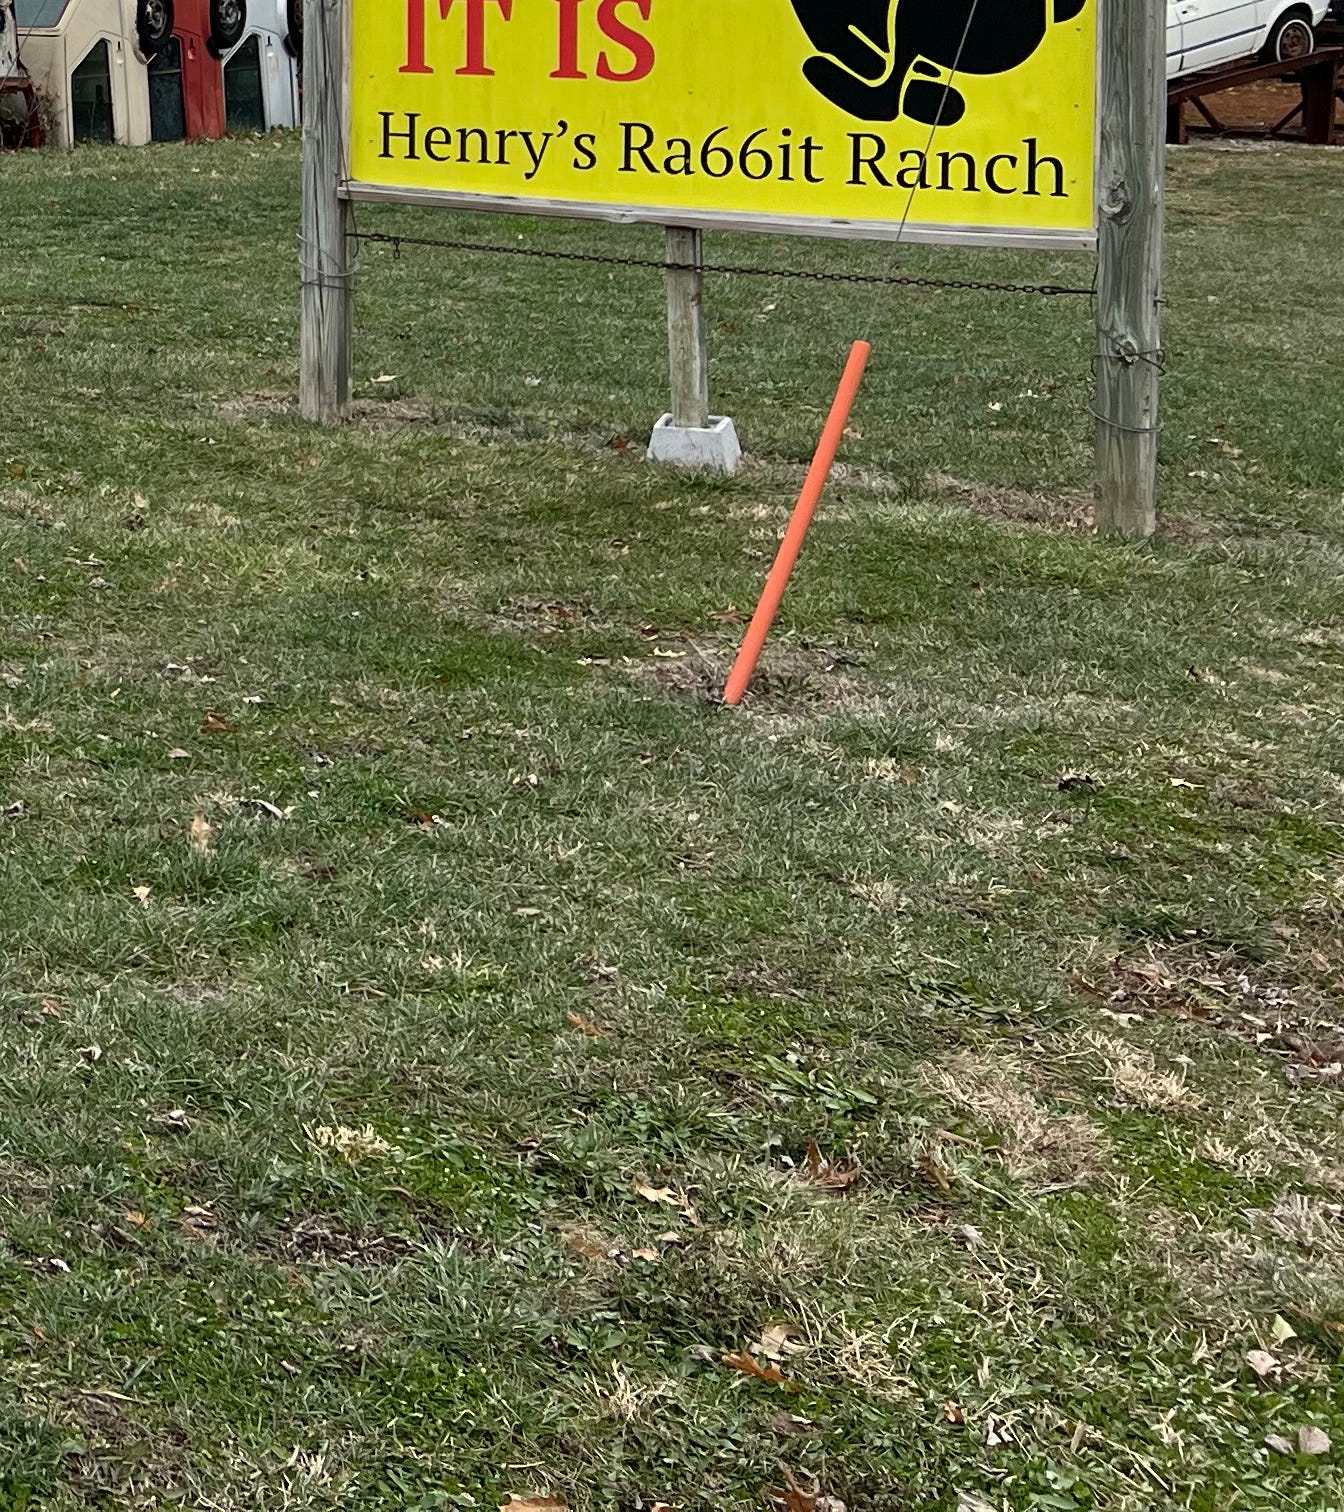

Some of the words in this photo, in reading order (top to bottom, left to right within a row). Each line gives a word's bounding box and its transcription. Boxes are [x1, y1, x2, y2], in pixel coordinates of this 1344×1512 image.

[377, 110, 598, 180] Henry's
[617, 121, 825, 184] Ra66it
[844, 132, 1070, 198] Ranch
